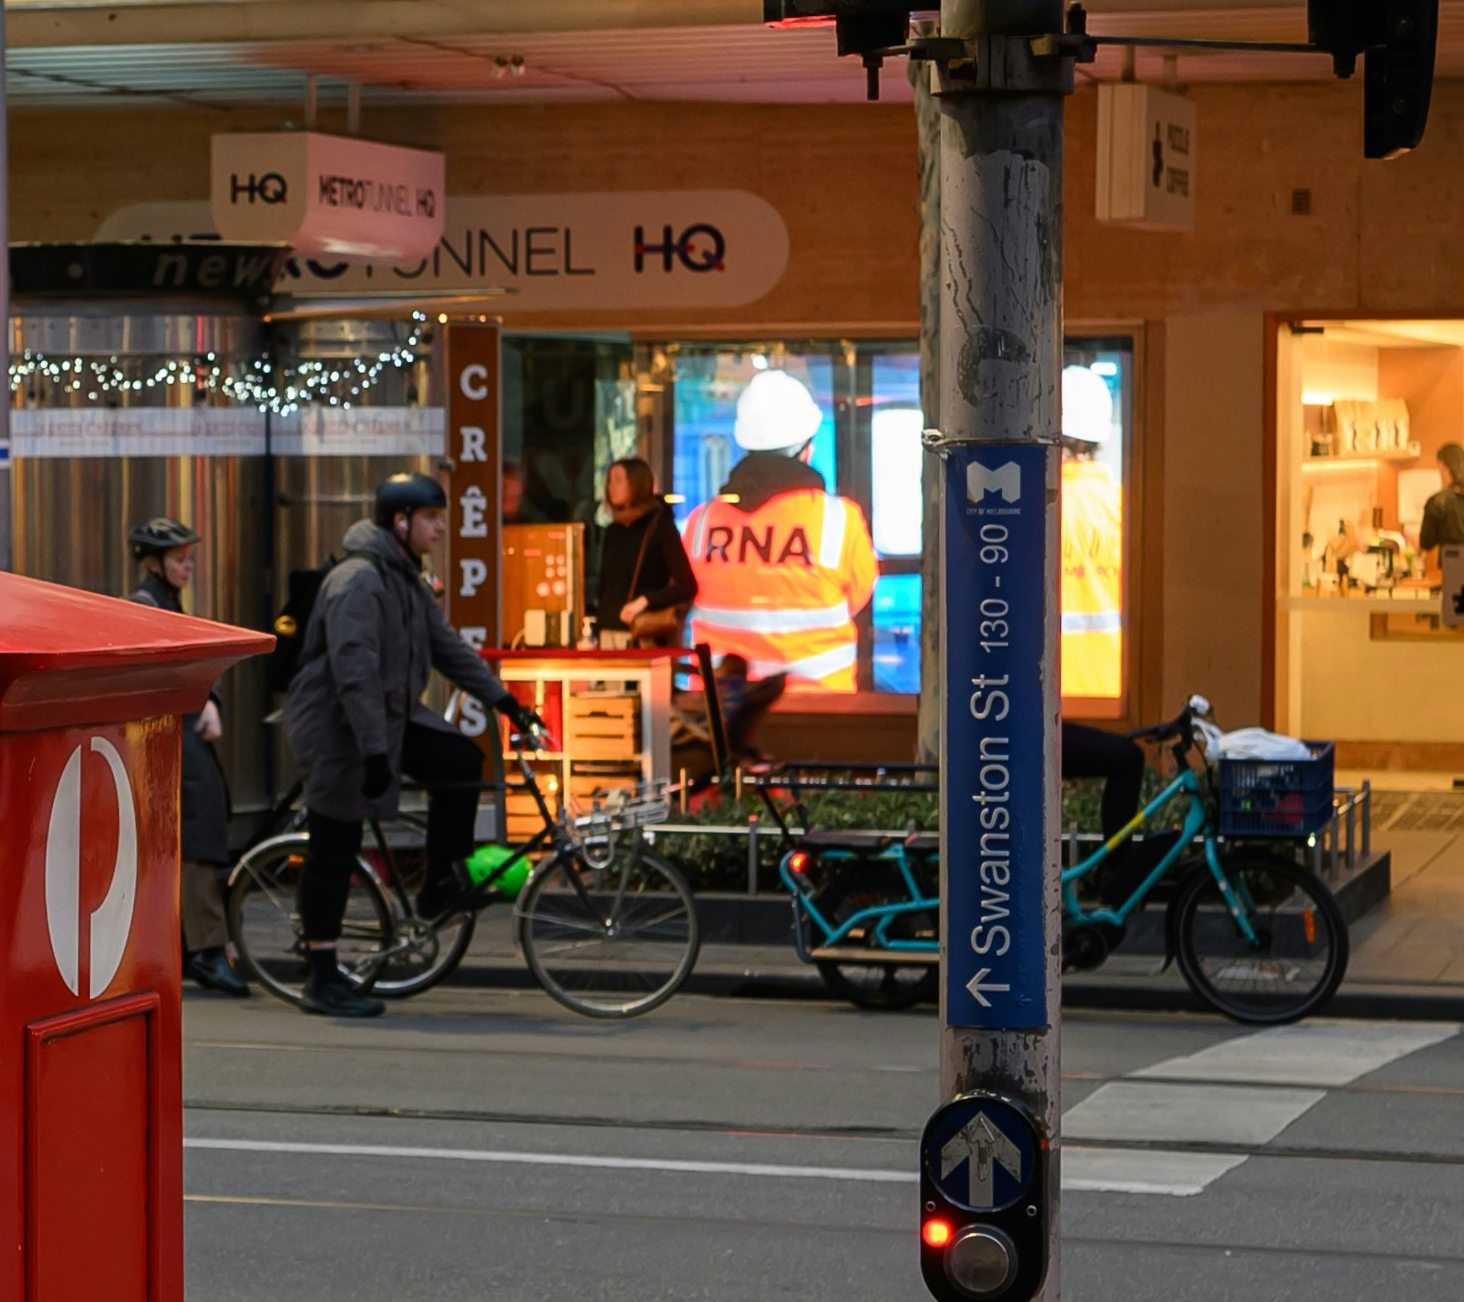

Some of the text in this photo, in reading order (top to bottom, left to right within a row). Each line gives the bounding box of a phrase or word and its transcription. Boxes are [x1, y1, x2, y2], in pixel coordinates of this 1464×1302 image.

[231, 173, 287, 205] HQ
[633, 223, 726, 274] HQ
[705, 525, 812, 567] RNA
[979, 523, 1009, 564] 90
[979, 598, 1009, 653] 130
[969, 674, 1010, 722] St
[970, 737, 1010, 957] Swanston
